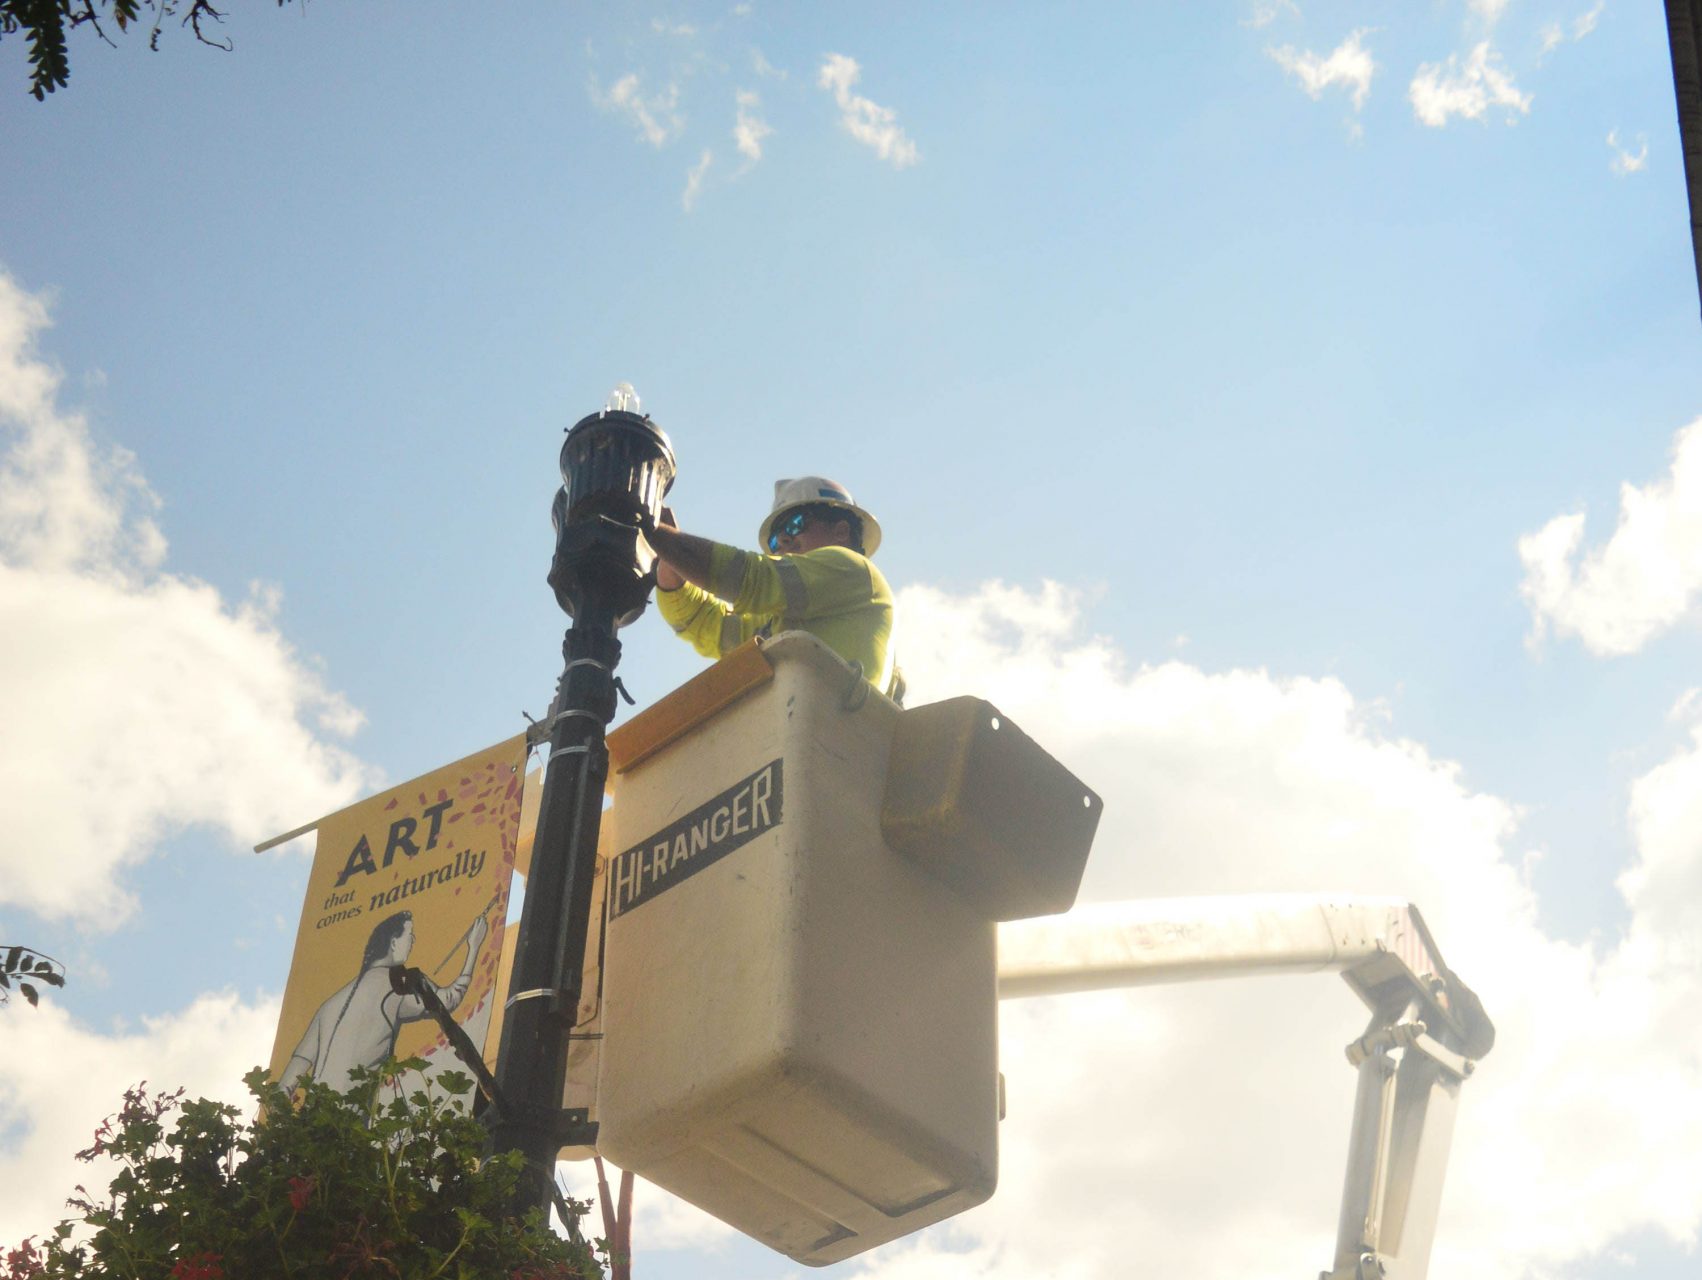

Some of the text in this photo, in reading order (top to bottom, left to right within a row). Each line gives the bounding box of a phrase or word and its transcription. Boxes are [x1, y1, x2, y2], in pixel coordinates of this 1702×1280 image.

[334, 798, 455, 888] ART
[614, 765, 772, 916] HI-RANGER
[316, 848, 487, 929] comes naturally
[323, 889, 356, 910] that
